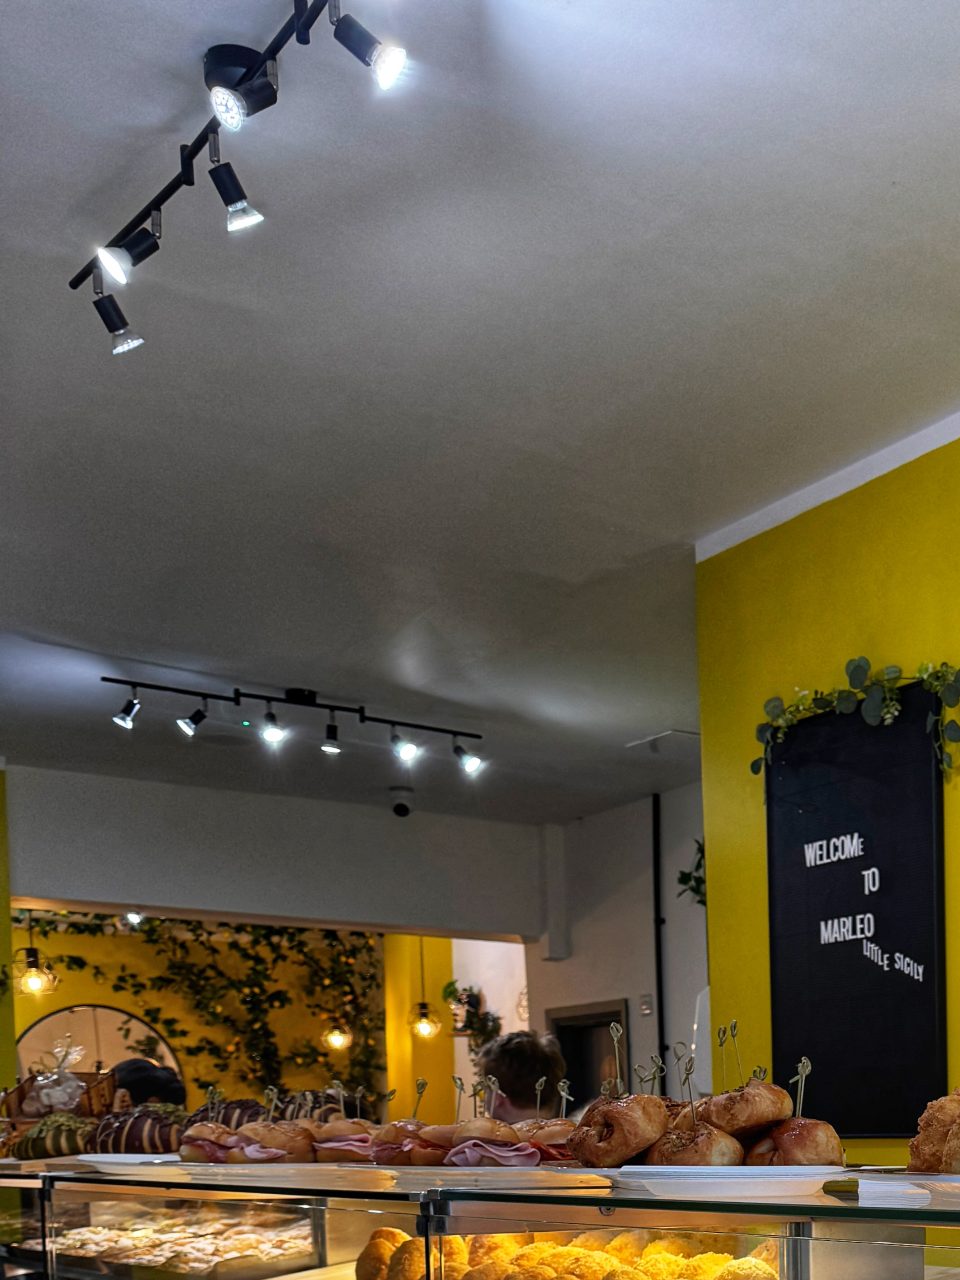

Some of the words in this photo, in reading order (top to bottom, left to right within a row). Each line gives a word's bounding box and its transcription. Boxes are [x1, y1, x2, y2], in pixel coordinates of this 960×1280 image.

[804, 832, 864, 867] WELCOME
[862, 867, 880, 895] TO
[820, 913, 875, 944] MARLEO
[863, 939, 890, 971] LITTLE
[894, 952, 924, 983] SICILY
